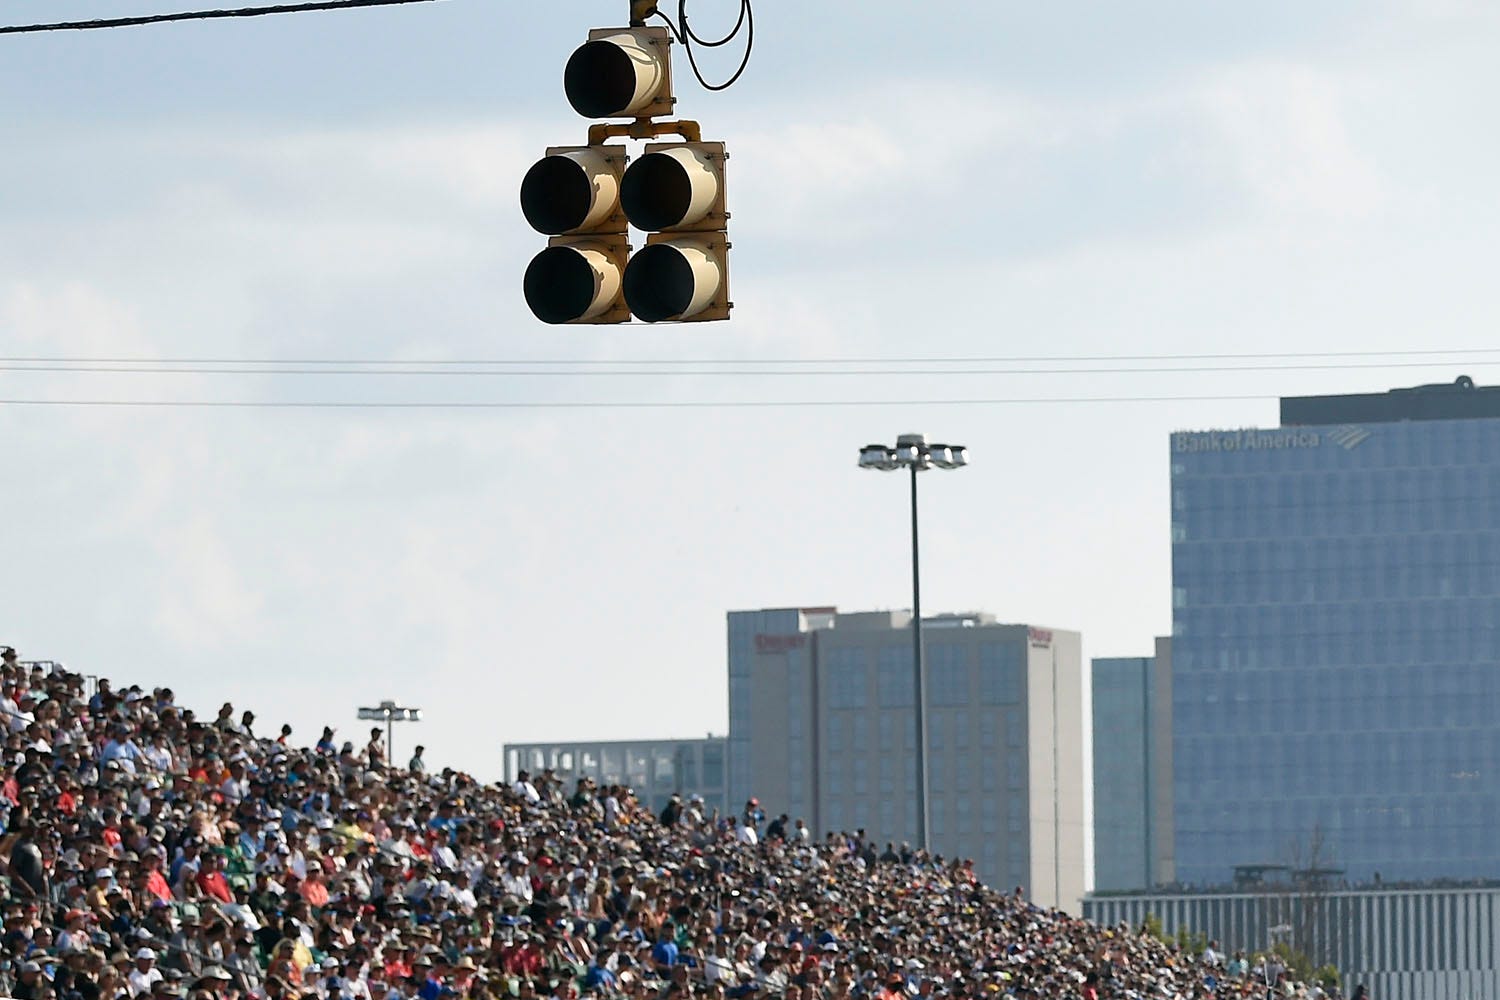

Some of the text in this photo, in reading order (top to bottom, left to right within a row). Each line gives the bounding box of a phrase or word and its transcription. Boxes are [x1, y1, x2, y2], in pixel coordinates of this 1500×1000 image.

[1176, 430, 1320, 452] Bank of America
